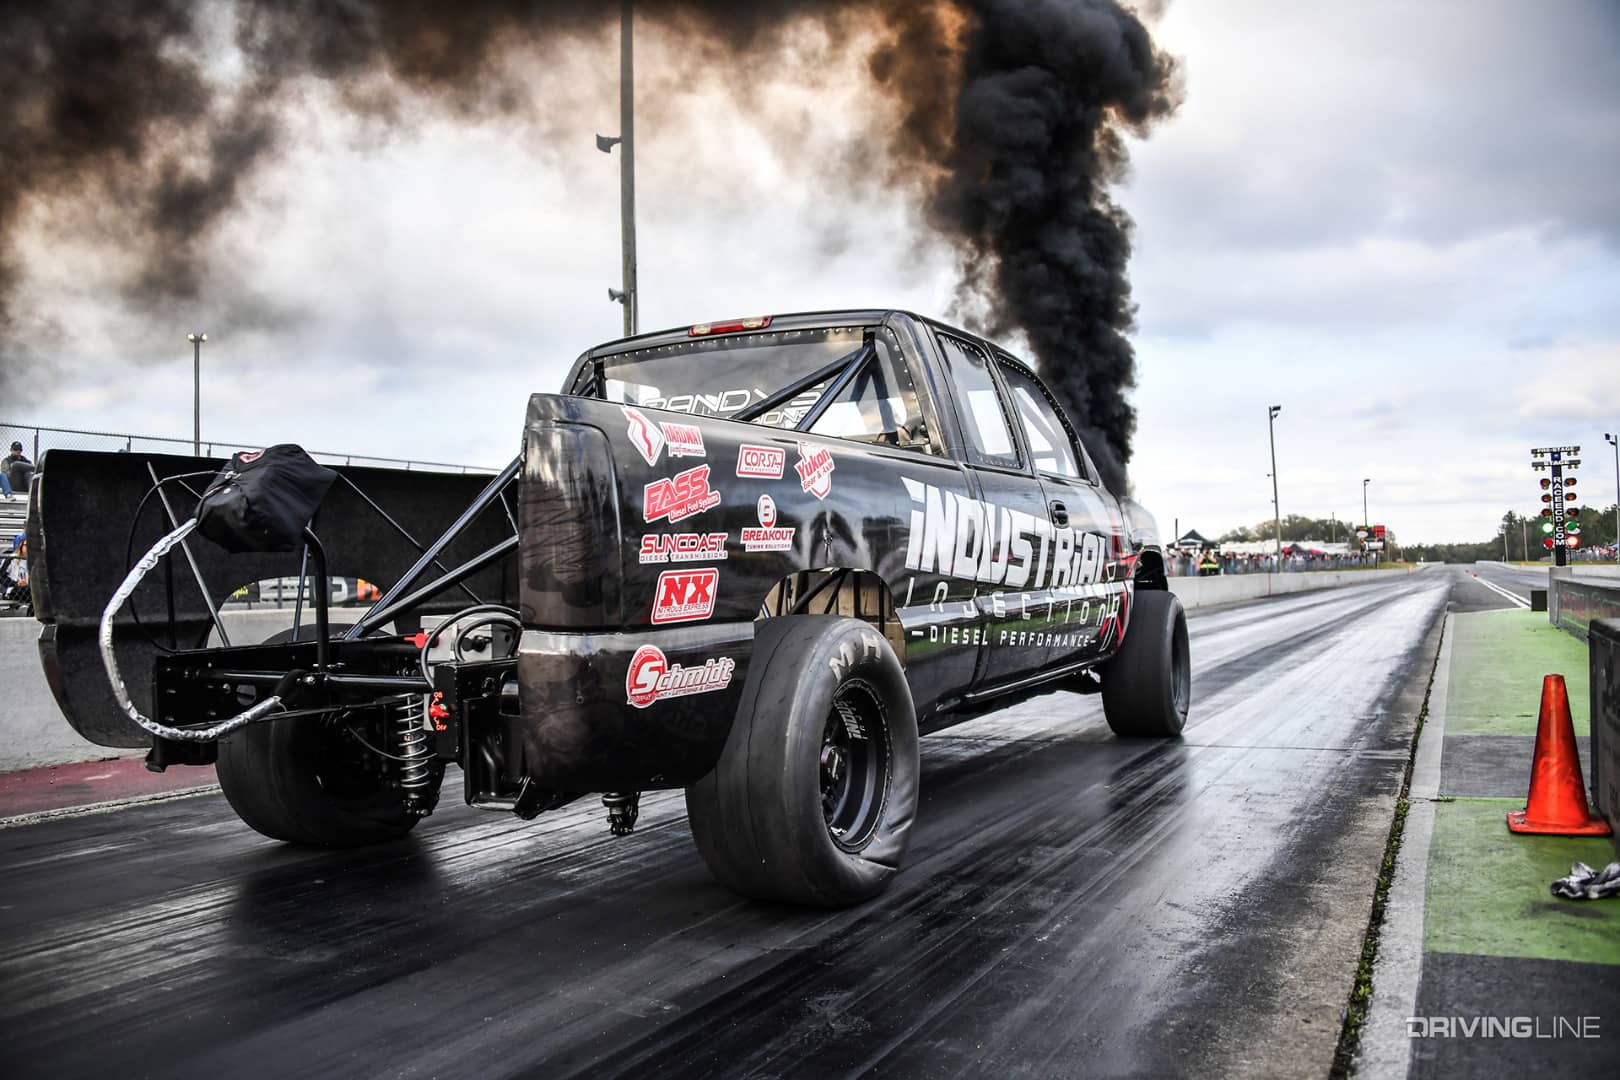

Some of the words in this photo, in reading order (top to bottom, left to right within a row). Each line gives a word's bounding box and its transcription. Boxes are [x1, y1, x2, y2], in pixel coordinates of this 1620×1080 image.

[744, 451, 782, 468] CORSA
[797, 449, 830, 481] Yukon
[645, 467, 709, 518] FASS
[641, 534, 727, 553] SUNCOAST
[742, 530, 793, 541] BREAKOUT
[660, 575, 713, 606] NX
[631, 657, 735, 694] Schmidt
